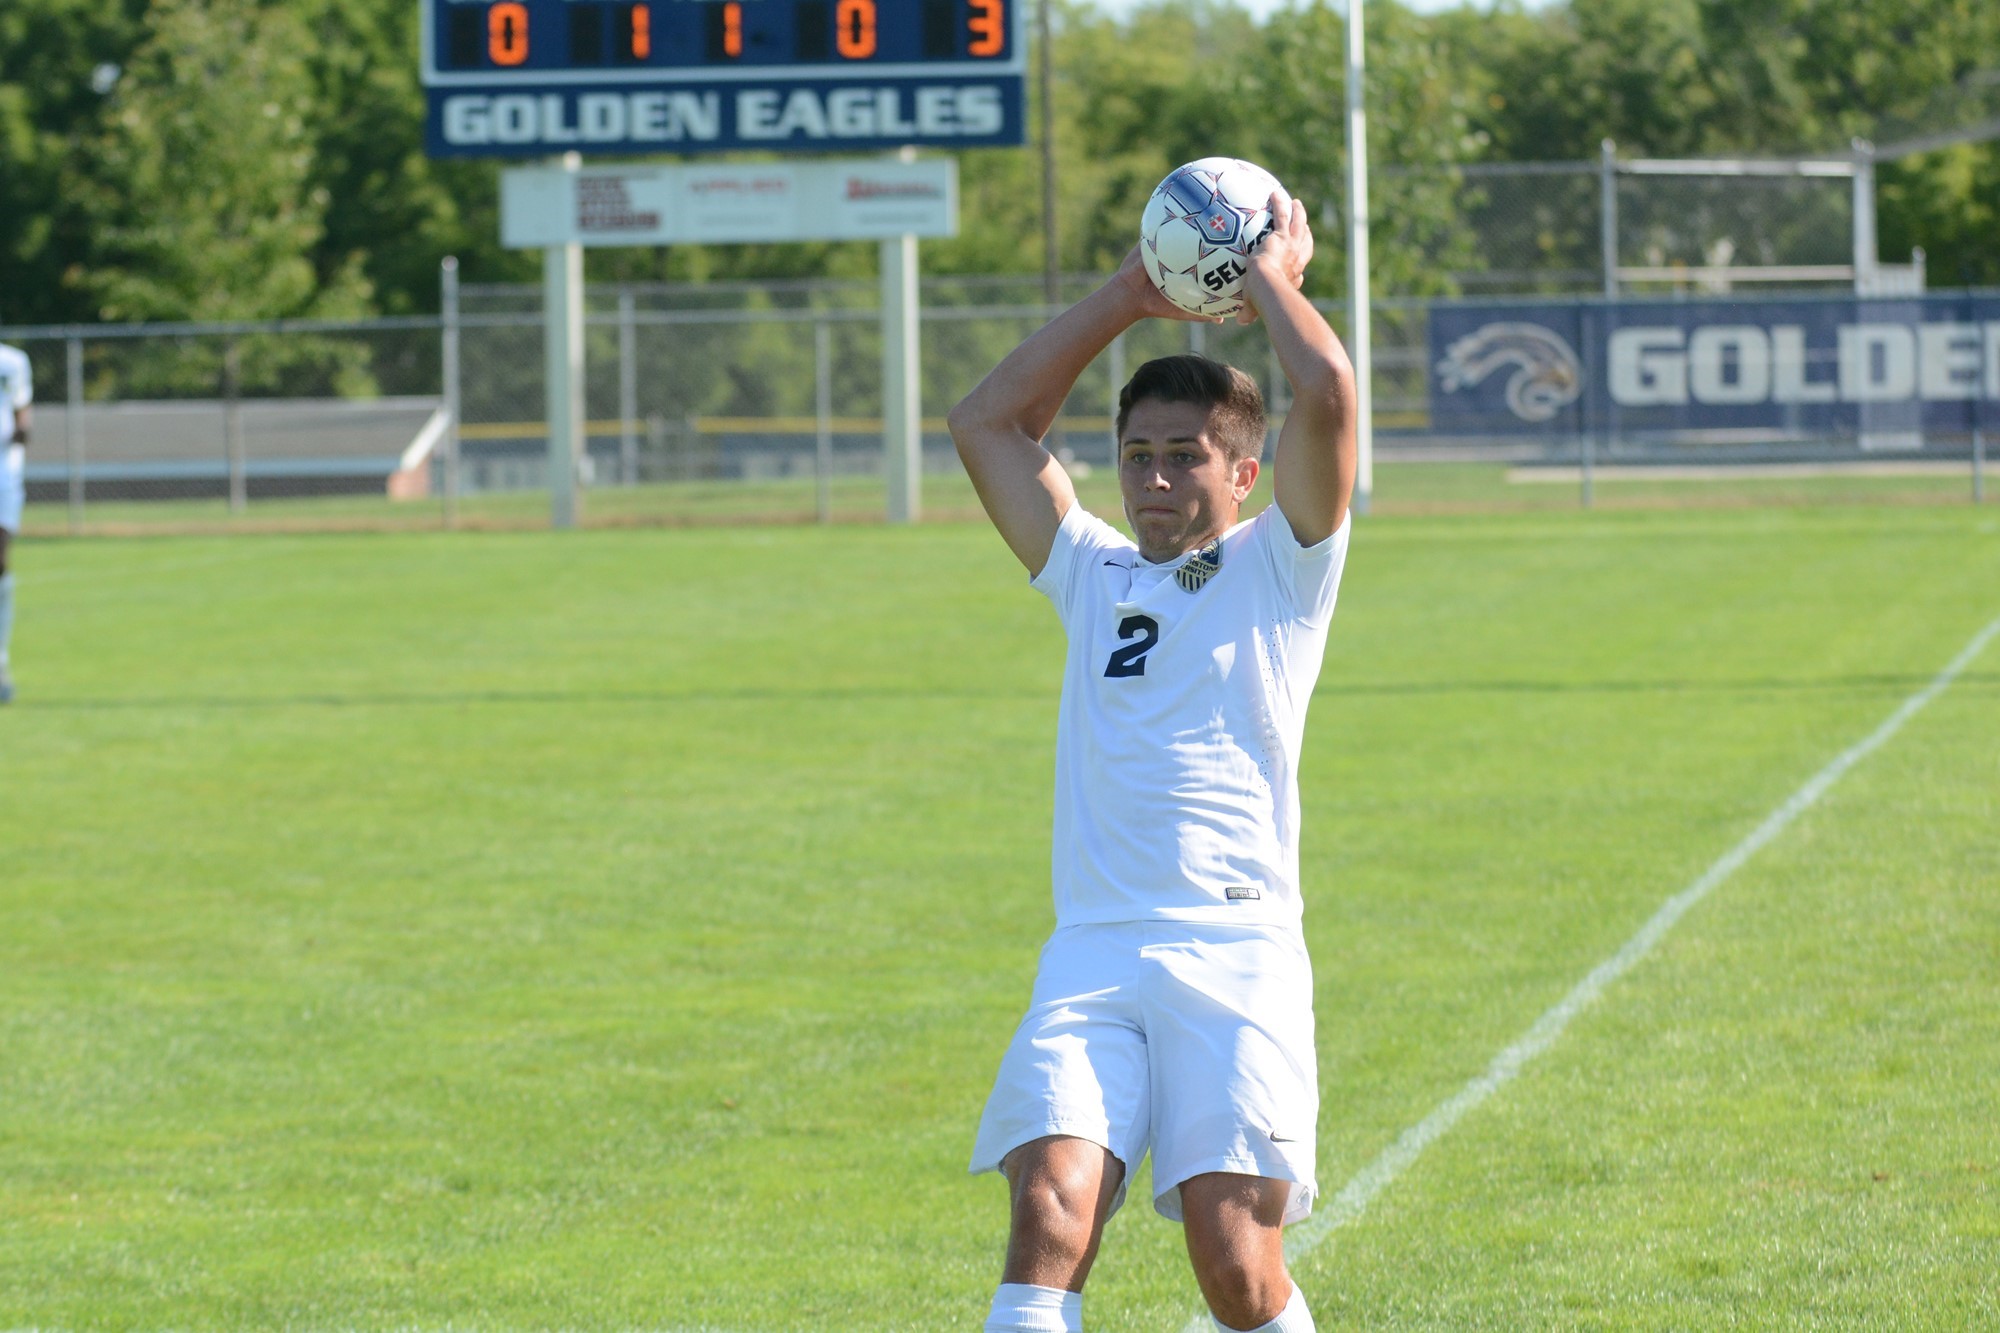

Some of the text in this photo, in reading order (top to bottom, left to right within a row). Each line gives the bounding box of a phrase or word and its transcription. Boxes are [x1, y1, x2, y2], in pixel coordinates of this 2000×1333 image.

[488, 0, 1003, 66] 0 1 1 0 3
[443, 87, 1002, 144] GOLDEN EAGLES
[1203, 258, 1247, 292] SEL
[1608, 322, 2000, 405] GOLDE
[1103, 614, 1159, 678] 2
